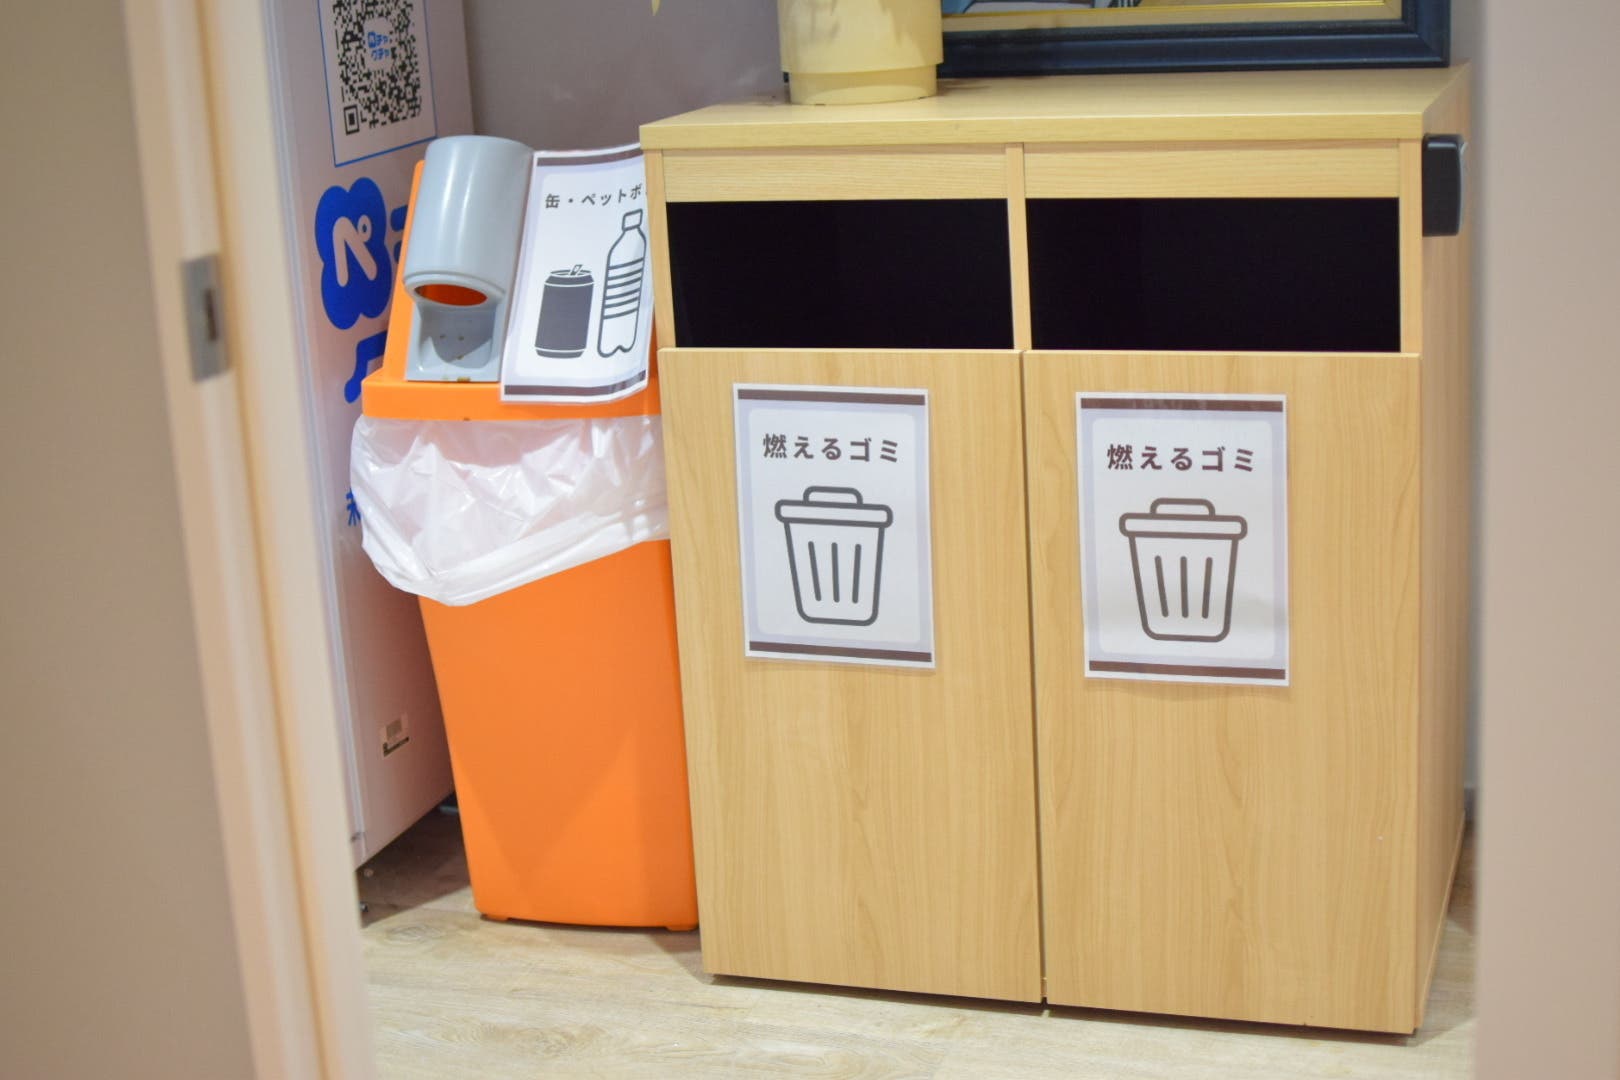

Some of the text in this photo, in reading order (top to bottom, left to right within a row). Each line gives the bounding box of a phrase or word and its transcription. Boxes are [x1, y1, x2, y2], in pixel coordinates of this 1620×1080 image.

[545, 183, 647, 208] 缶・ペットボ
[763, 433, 898, 463] 燃えるゴミ
[1106, 443, 1253, 472] 燃えるゴミ
